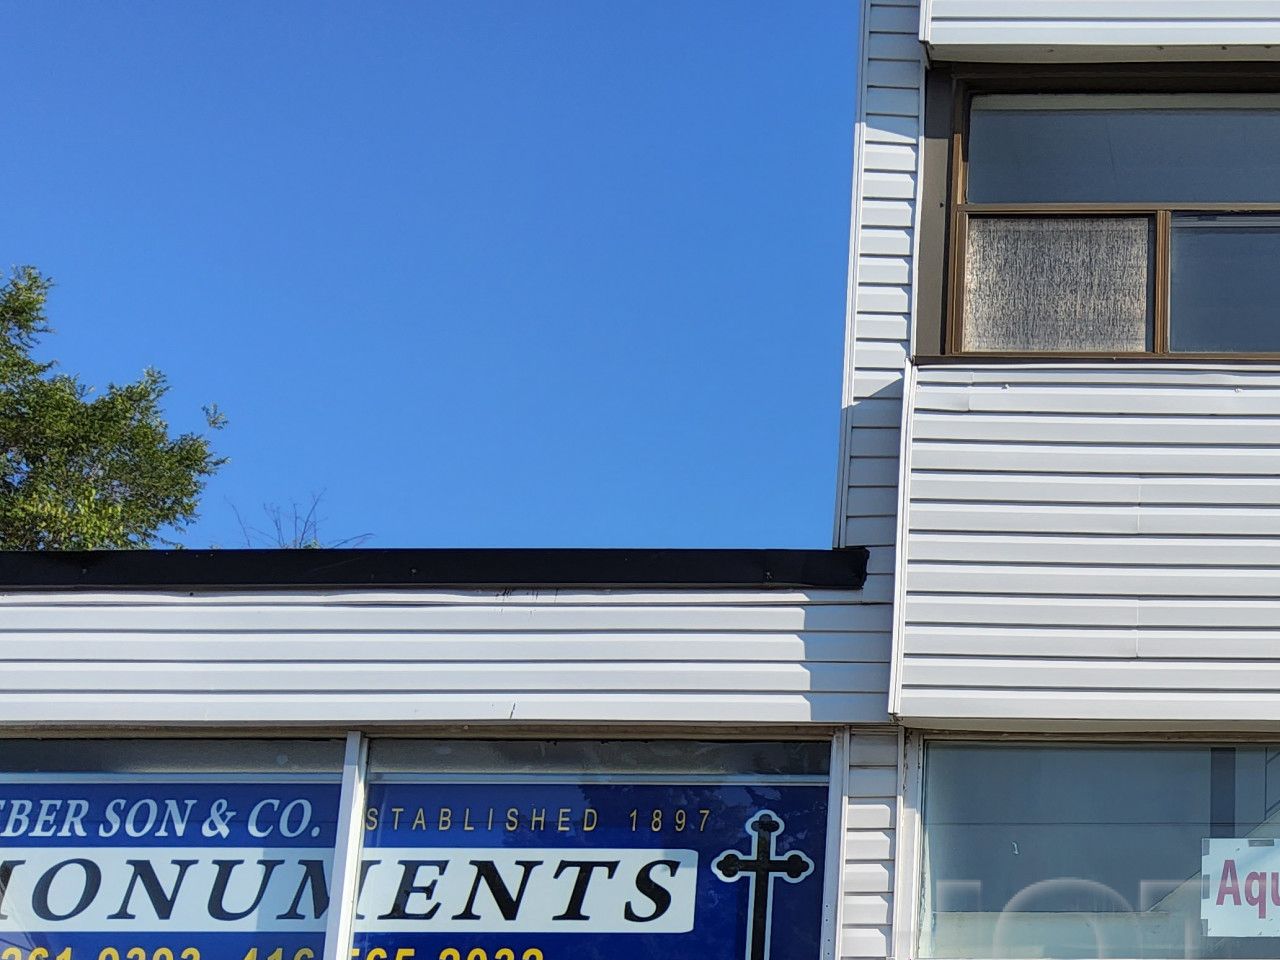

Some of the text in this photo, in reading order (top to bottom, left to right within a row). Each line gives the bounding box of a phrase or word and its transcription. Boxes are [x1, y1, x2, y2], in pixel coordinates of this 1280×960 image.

[0, 798, 321, 840] BER SON & CO.
[628, 808, 711, 833] 1897
